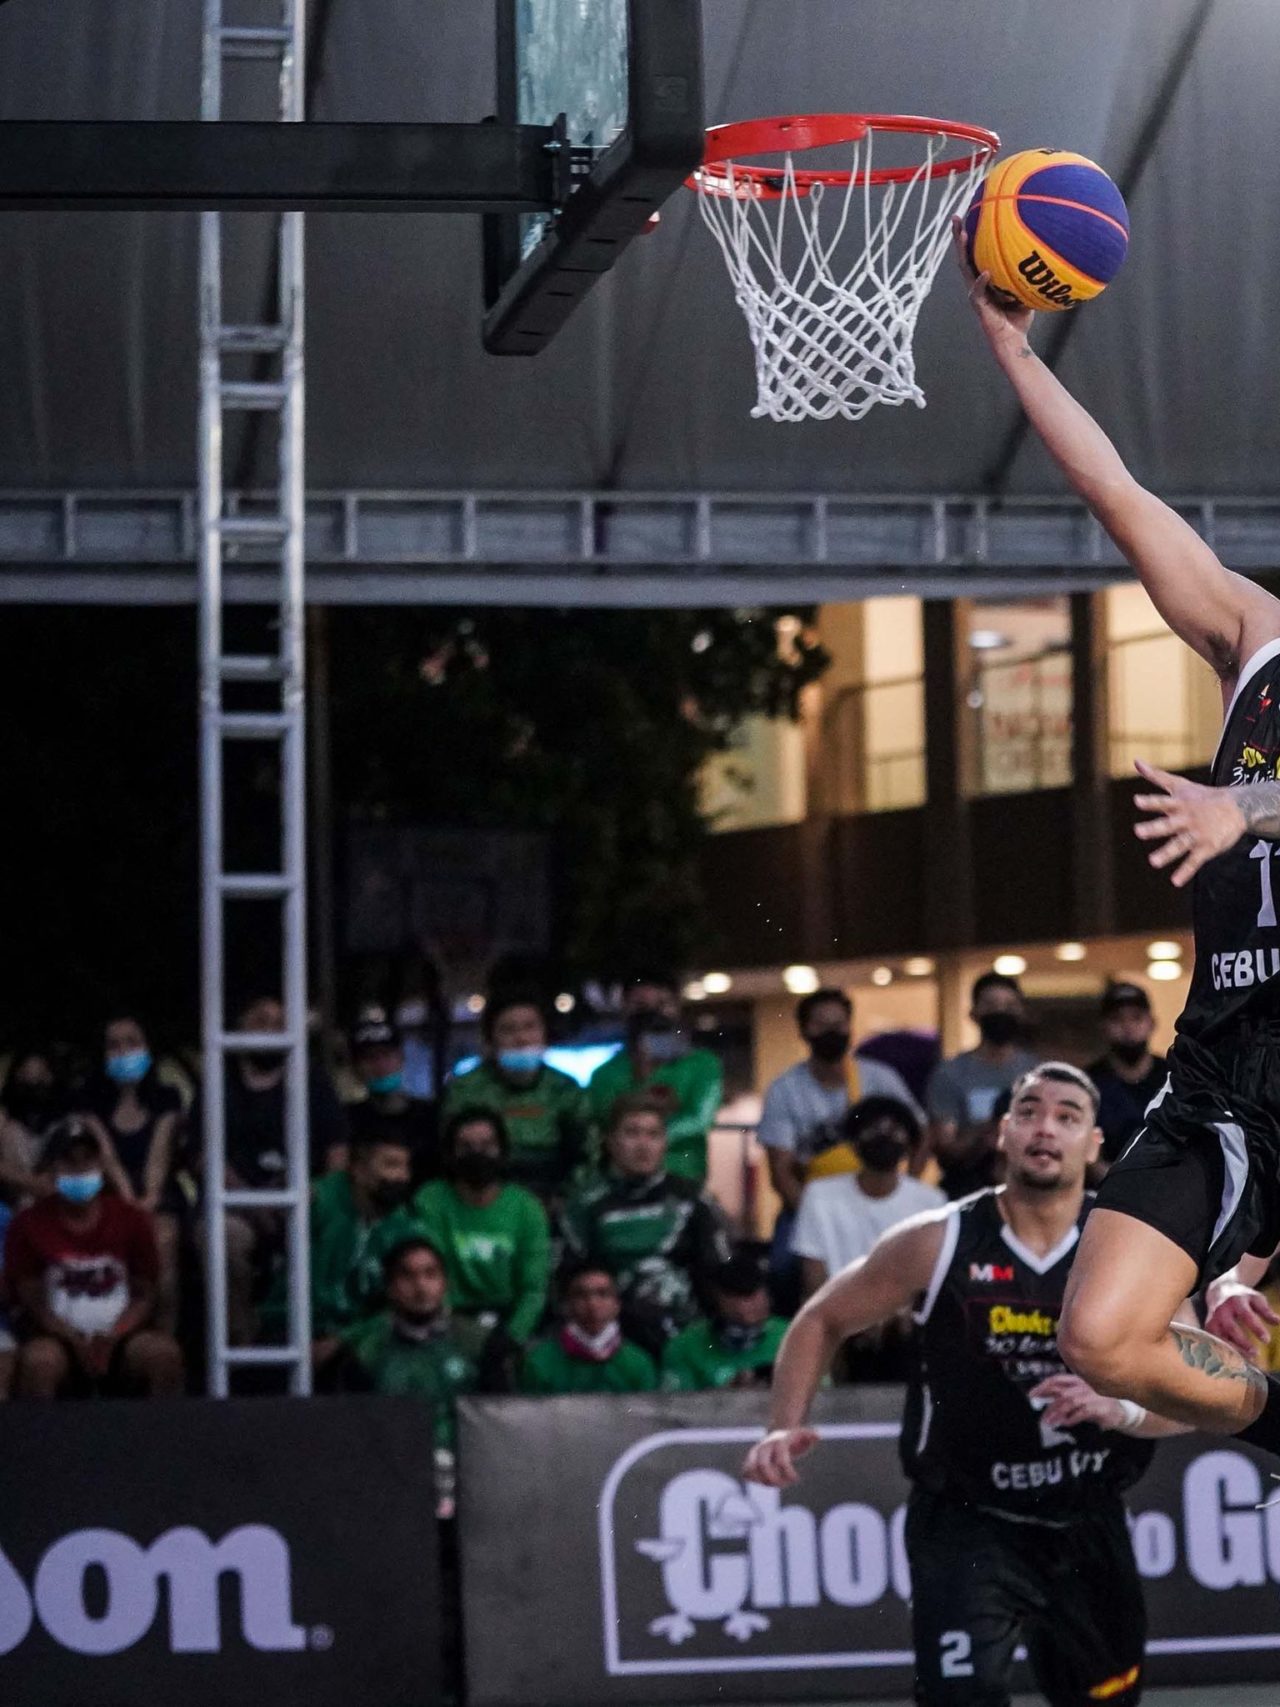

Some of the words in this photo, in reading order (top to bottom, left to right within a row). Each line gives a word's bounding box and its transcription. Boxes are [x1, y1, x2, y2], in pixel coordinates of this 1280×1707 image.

[1211, 948, 1280, 991] CEBU
[991, 1456, 1063, 1490] CEBU
[939, 1629, 975, 1679] 2
